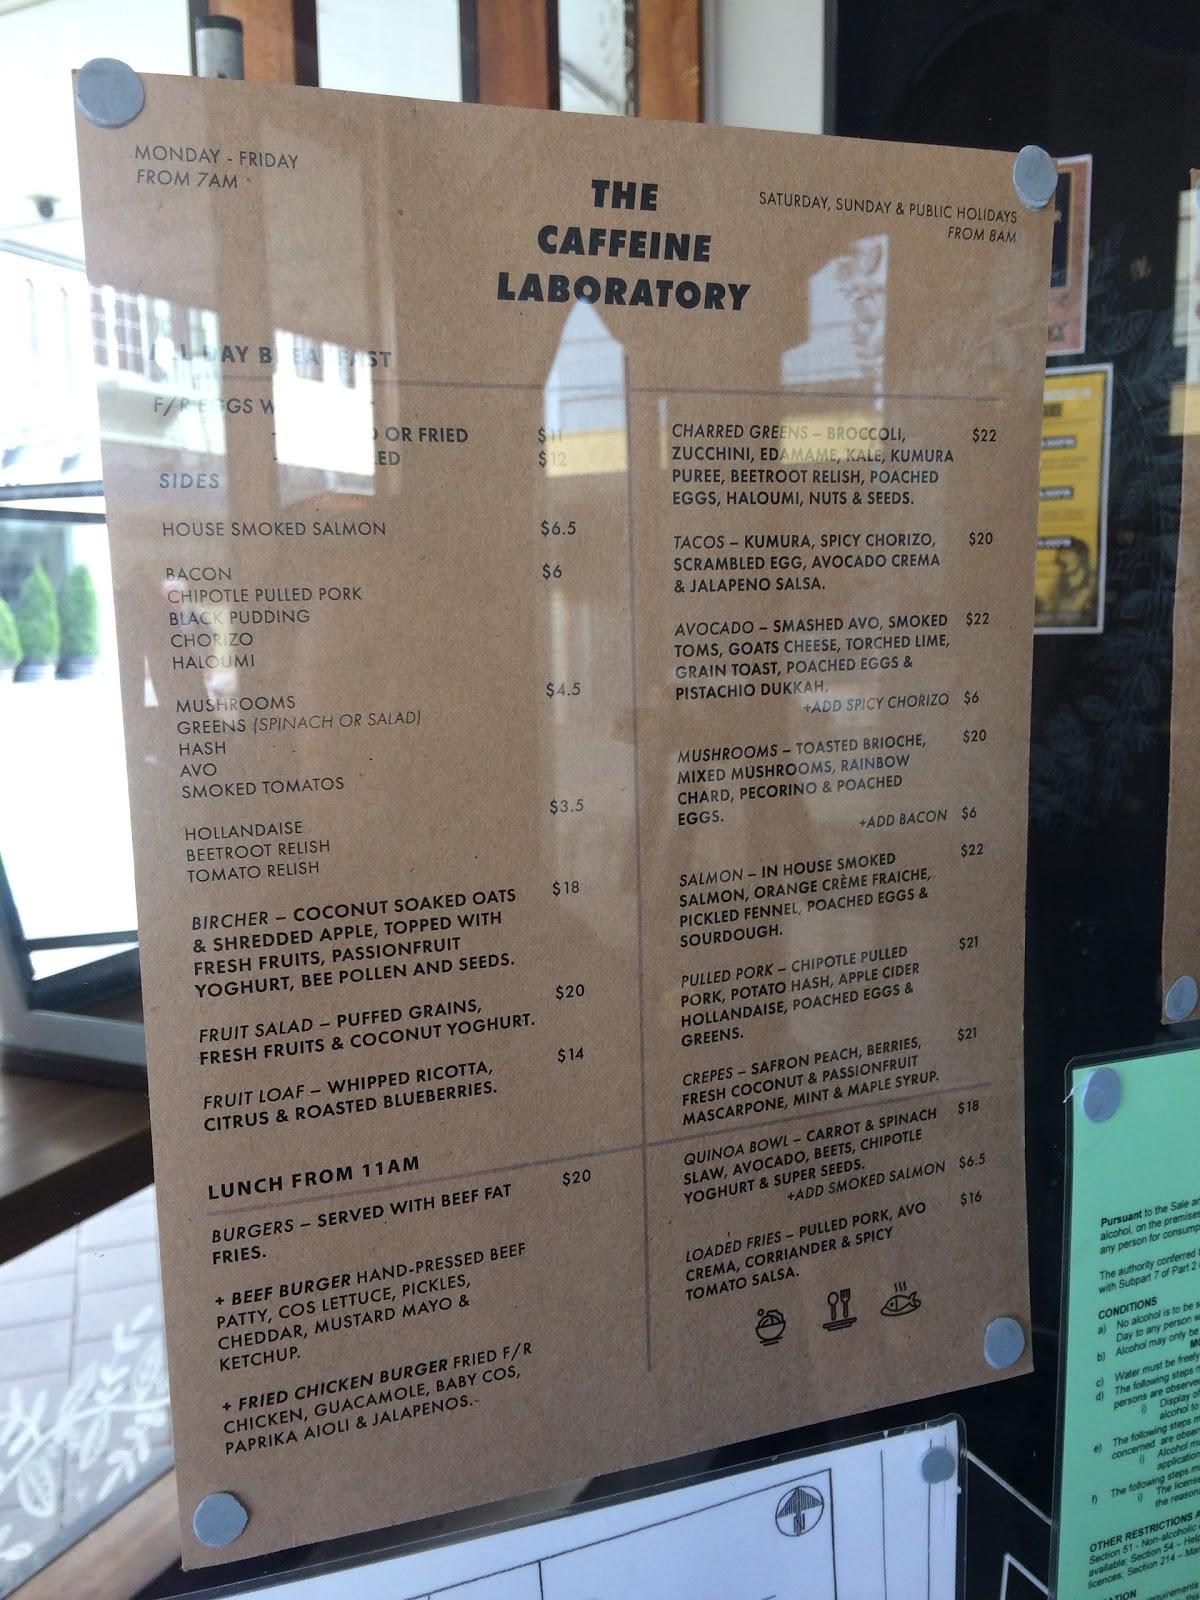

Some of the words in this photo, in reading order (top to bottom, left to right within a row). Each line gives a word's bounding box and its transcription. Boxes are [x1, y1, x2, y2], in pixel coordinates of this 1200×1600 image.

[135, 145, 220, 162] MONDAY
[239, 151, 298, 168] FRIDAY
[137, 169, 190, 185] FROM
[196, 172, 237, 188] 7AM
[592, 179, 658, 212] THE
[759, 192, 830, 210] SATURDAY,
[835, 198, 891, 212] SUNDAY
[895, 202, 904, 214] &
[909, 203, 952, 217] PUBLIC
[957, 207, 1017, 222] HOLIDAYS
[948, 226, 984, 239] FROM
[987, 229, 1016, 242] 8AM
[538, 225, 713, 262] CAFFEINE
[497, 271, 751, 311] LABORATORY
[385, 426, 412, 442] OR
[419, 427, 468, 443] FRIED
[972, 427, 996, 442] $22
[159, 472, 218, 488] SIDES
[672, 469, 724, 483] PUREE,
[730, 469, 808, 482] BEETROOT
[812, 470, 864, 484] RELISH,
[870, 470, 938, 483] POACHED
[673, 491, 720, 506] EGGS,
[726, 491, 803, 505] HALOUMI,
[809, 491, 846, 504] NUTS
[852, 491, 862, 504] &
[867, 491, 913, 504] SEEDS.
[162, 522, 224, 535] HOUSE
[231, 522, 306, 535] SMOKED
[312, 521, 385, 535] SALMON
[541, 520, 576, 536] $6.5
[969, 531, 993, 545] $20
[542, 563, 562, 579] $6
[674, 556, 764, 570] SCRAMBLED
[770, 555, 806, 570] EGG,
[811, 555, 886, 567] AVOCADO
[891, 554, 939, 566] CREMA
[166, 567, 231, 580] BACON
[167, 589, 248, 602] CHIPOTLE
[254, 588, 312, 601] PULLED
[319, 587, 362, 599] PORK
[169, 611, 223, 625] BLACK
[230, 610, 309, 623] PUDDING
[170, 632, 253, 647] CHORIZO
[674, 643, 722, 657] TOMS,
[728, 641, 779, 654] GOATS
[784, 639, 840, 652] CHEESE,
[845, 636, 910, 649] TORCHED
[915, 634, 949, 647] LIME,
[172, 654, 254, 669] HALOUMI
[546, 682, 580, 697] $4.5
[176, 696, 295, 712] MUSHROOMS
[176, 719, 246, 734] GREENS
[251, 715, 333, 733] (SPINACH
[339, 713, 361, 726] OR
[366, 710, 420, 725] SALAD)
[179, 741, 225, 755] HASH
[180, 763, 216, 776] AVO
[182, 782, 256, 797] SMOKED
[261, 777, 343, 792] TOMATOS
[550, 798, 583, 814] $3.5
[962, 806, 976, 820] $6
[859, 814, 894, 827] +ADD
[899, 809, 947, 824] BACON
[185, 821, 302, 839] HOLLANDAISE
[186, 844, 271, 861] BEETROOT
[278, 840, 329, 857] RELISH
[187, 866, 260, 881] TOMATO
[267, 861, 318, 876] RELISH
[552, 881, 579, 895] $18
[680, 925, 782, 946] SOURDOUGH.
[959, 936, 978, 950] $21
[194, 958, 251, 974] FRESH
[258, 951, 324, 968] FRUITS,
[332, 937, 460, 961] PASSIONFRUIT
[194, 976, 294, 996] YOGHURT,
[301, 972, 332, 986] BEE
[339, 965, 406, 982] POLLEN
[413, 960, 452, 975] AND
[459, 953, 514, 970] SEEDS.
[556, 984, 584, 999] $20
[681, 1027, 743, 1046] GREENS.
[557, 1047, 583, 1062] $14
[682, 1088, 725, 1105] FRESH
[731, 1074, 803, 1096] COCONUT
[807, 1072, 817, 1084] &
[822, 1055, 918, 1080] PASSIONFRUIT
[204, 1111, 268, 1130] CITRUS
[276, 1109, 288, 1122] &
[295, 1098, 377, 1118] ROASTED
[383, 1081, 496, 1107] BLUEBERRIES.
[683, 1166, 727, 1184] SLAW,
[732, 1151, 809, 1174] AVOCADO,
[814, 1142, 855, 1158] BEETS,
[860, 1129, 921, 1149] CHIPOTLE
[208, 1177, 282, 1198] LUNCH
[292, 1166, 352, 1187] FROM
[362, 1156, 418, 1176] 11AM
[562, 1169, 590, 1186] $20
[960, 1191, 981, 1205] $16
[1101, 1211, 1142, 1227] Pursuant
[1155, 1205, 1168, 1214] the
[1171, 1201, 1189, 1211] Sale
[1149, 1220, 1162, 1229] the
[1100, 1245, 1116, 1254] any
[1118, 1236, 1147, 1252] person
[1150, 1233, 1161, 1242] for
[213, 1246, 266, 1263] FRIES.
[1099, 1271, 1116, 1280] The
[1119, 1261, 1155, 1276] authority
[1157, 1249, 1196, 1266] conferred
[685, 1277, 746, 1299] TOMATO
[752, 1267, 799, 1285] SALSA.
[1099, 1282, 1116, 1294] with
[1119, 1273, 1152, 1288] Subpart
[1172, 1264, 1190, 1275] Part
[217, 1309, 271, 1328] PATTY,
[278, 1301, 315, 1317] COS
[322, 1287, 395, 1310] LETTUCE,
[402, 1274, 470, 1295] PICKLES,
[1098, 1296, 1157, 1319] CONDITIONS
[1132, 1310, 1160, 1325] alcohol
[1116, 1332, 1133, 1342] Day
[1147, 1325, 1161, 1335] any
[1164, 1316, 1191, 1330] person
[1116, 1342, 1147, 1356] Alcohol
[1149, 1337, 1166, 1347] may
[1169, 1331, 1186, 1341] only
[220, 1346, 300, 1370] KETCHUP.
[1115, 1369, 1140, 1381] Water
[1143, 1362, 1163, 1374] must
[1113, 1437, 1128, 1447] The
[1131, 1425, 1167, 1441] following
[1170, 1419, 1191, 1430] steps
[1090, 1535, 1122, 1553] OTHER
[1125, 1513, 1192, 1541] RESTRICTIONS
